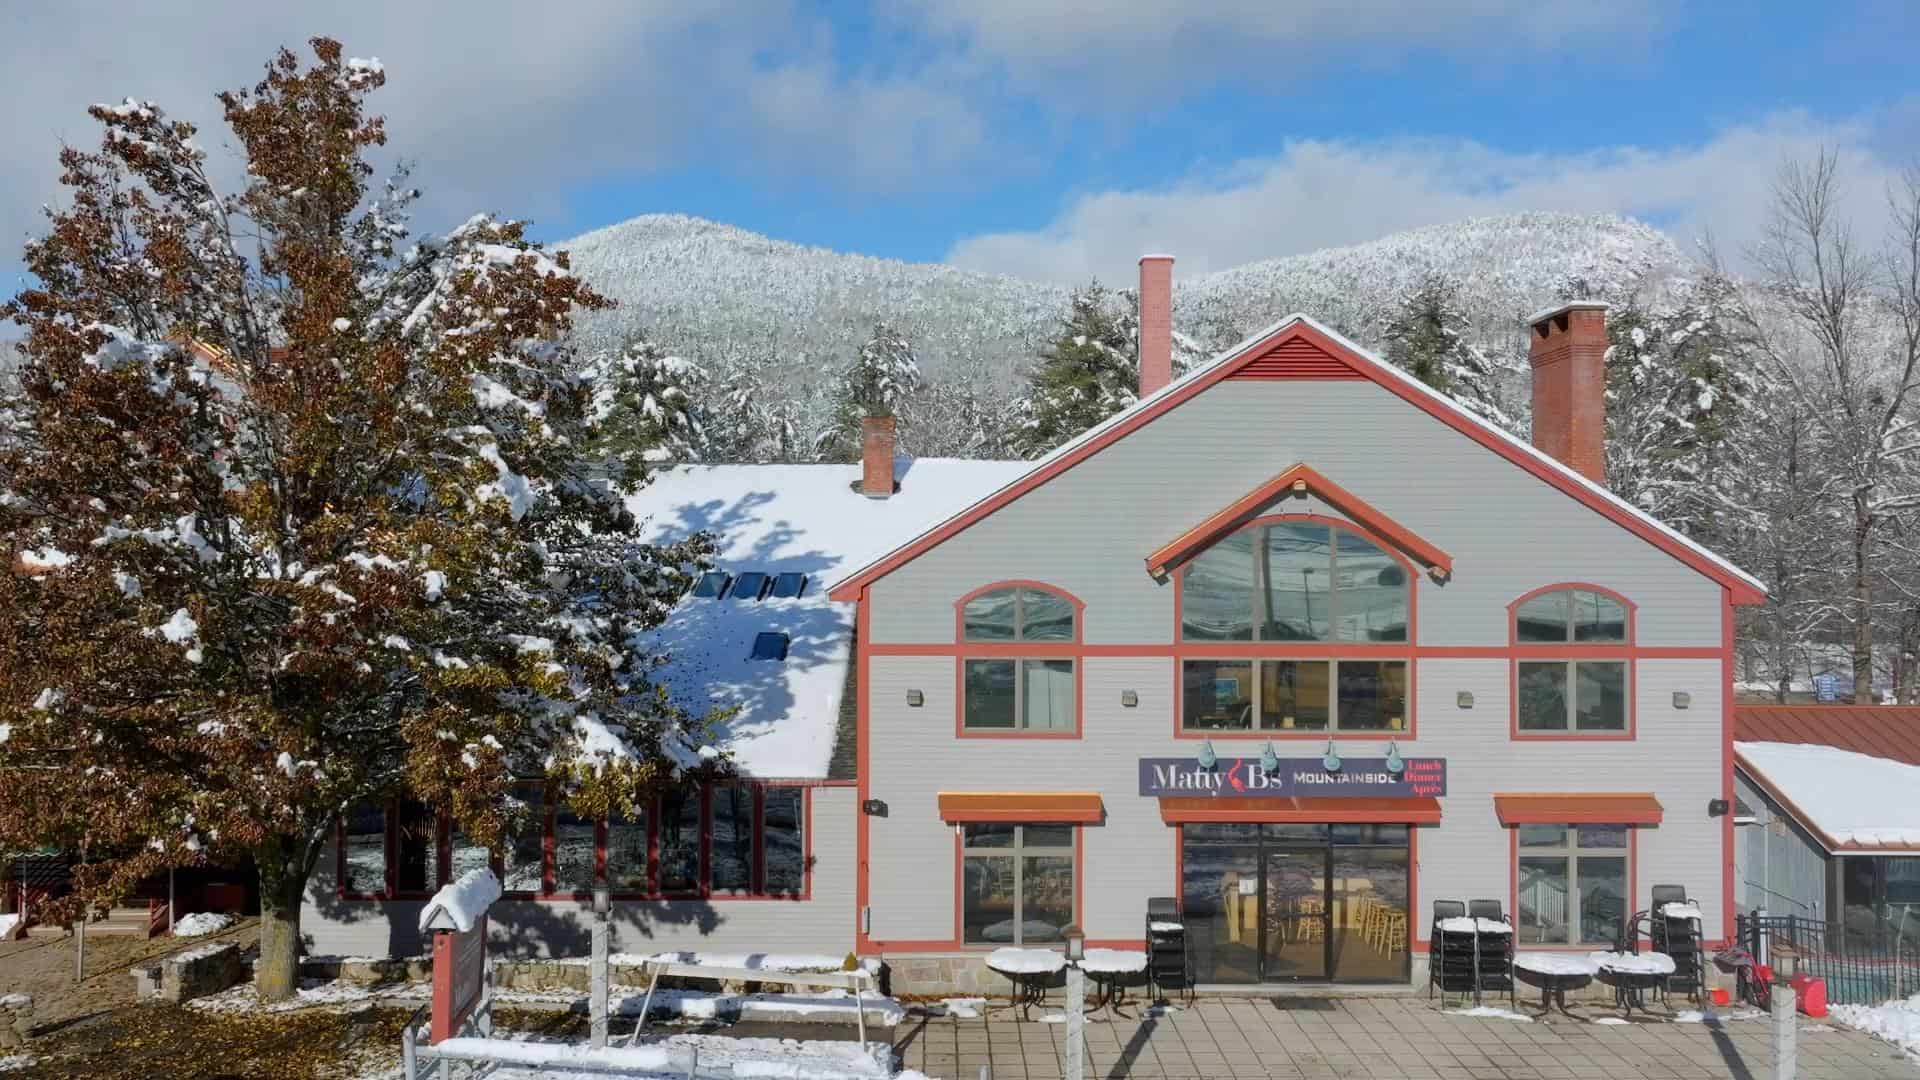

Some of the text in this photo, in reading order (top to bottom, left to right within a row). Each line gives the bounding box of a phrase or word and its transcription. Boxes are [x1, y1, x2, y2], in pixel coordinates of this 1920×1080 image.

[1408, 760, 1441, 771] Lunch
[1152, 764, 1226, 796] Matty
[1404, 771, 1441, 782] Dinner
